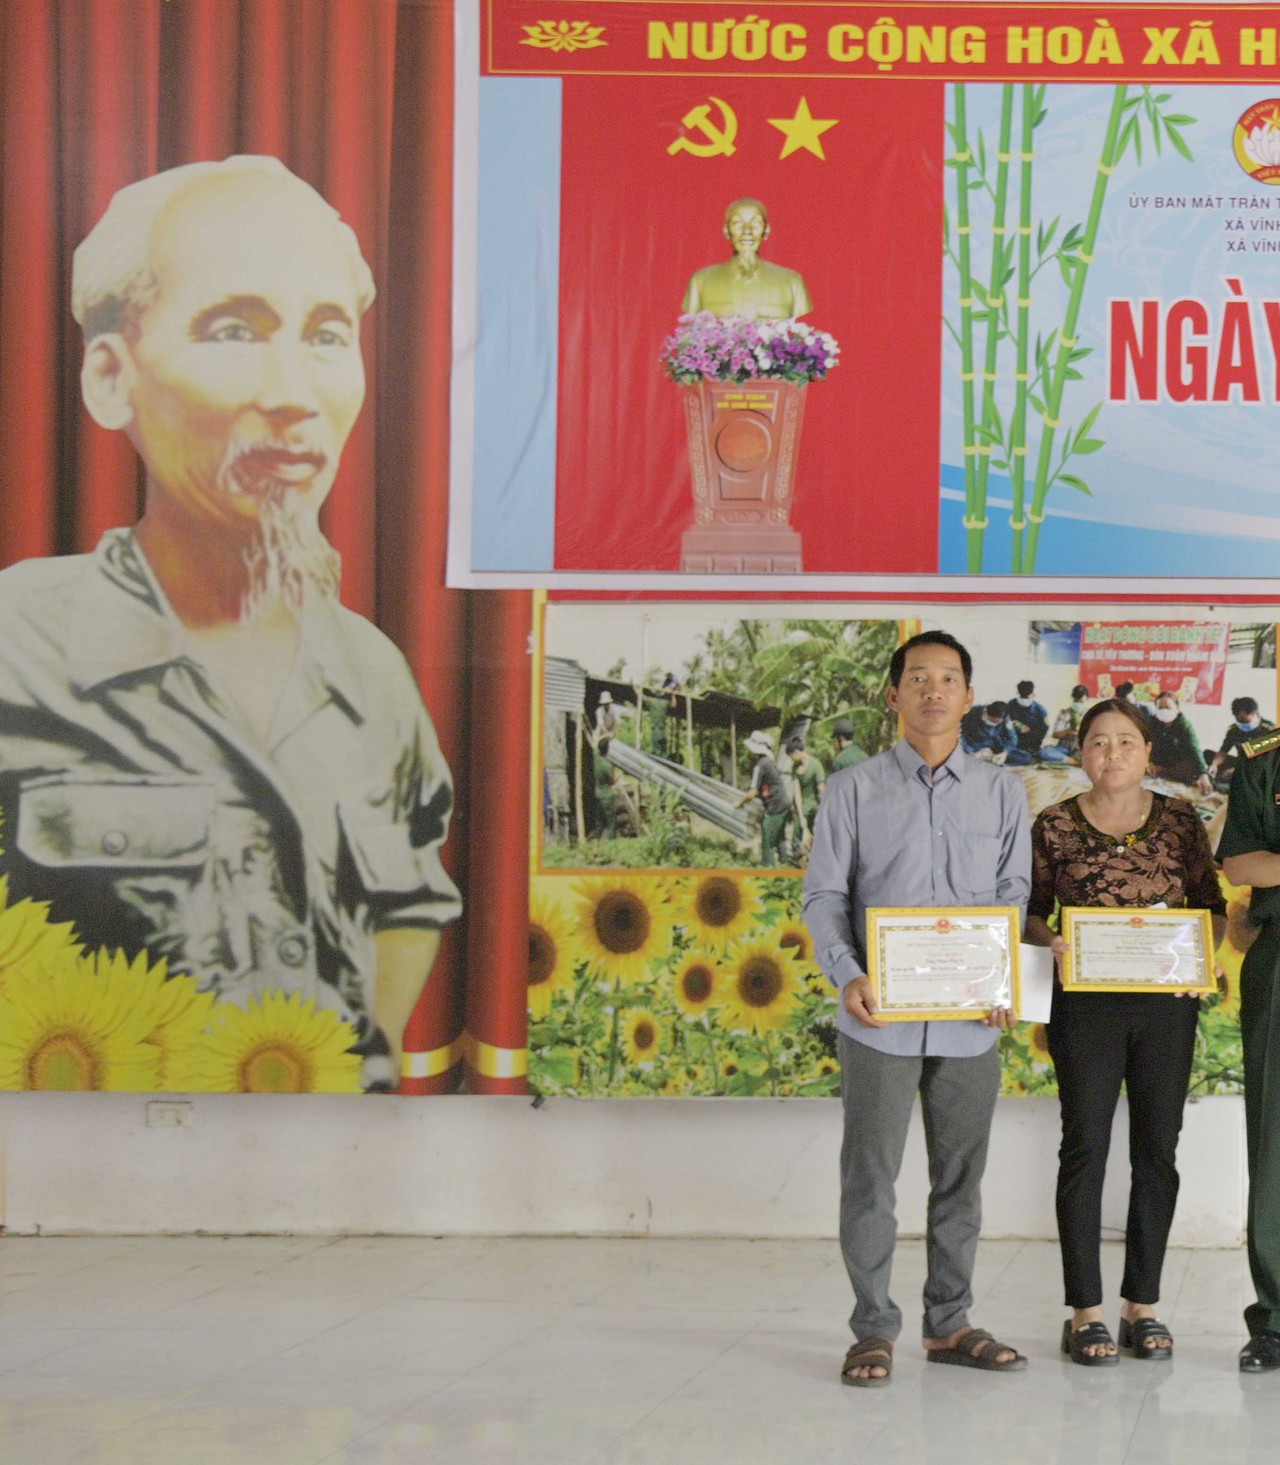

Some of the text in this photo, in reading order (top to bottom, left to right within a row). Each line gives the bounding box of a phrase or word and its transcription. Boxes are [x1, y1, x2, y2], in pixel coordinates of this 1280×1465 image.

[647, 15, 807, 61] NƯỚC
[828, 17, 986, 71] CỘNG
[1007, 19, 1124, 65] HOÀ
[1142, 20, 1221, 65] XÃ
[1129, 191, 1149, 209] ỦY
[1154, 196, 1186, 209] BAN
[1191, 195, 1224, 211] MẶT
[1229, 195, 1270, 211] TRẬN
